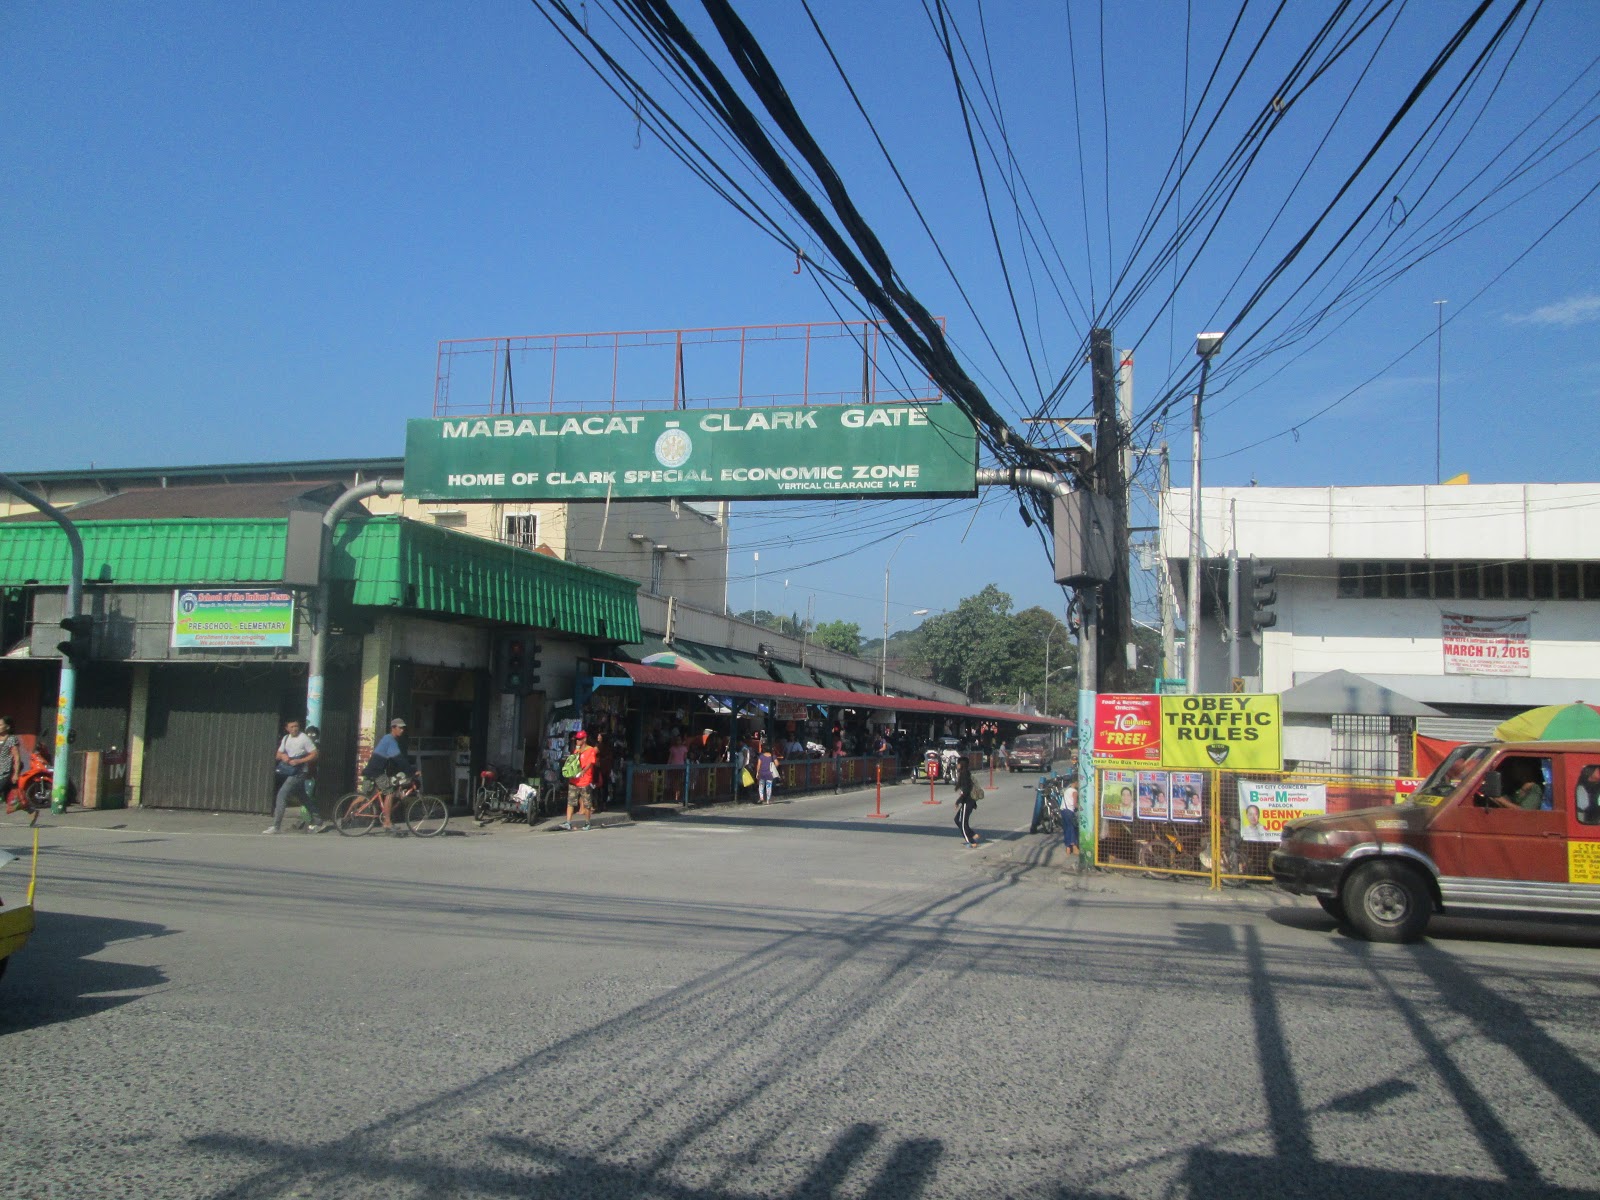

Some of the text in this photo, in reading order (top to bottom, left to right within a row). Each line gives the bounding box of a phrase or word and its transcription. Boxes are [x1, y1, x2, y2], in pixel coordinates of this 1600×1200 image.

[442, 416, 645, 438] MABALACAT
[699, 410, 818, 432] CLARK
[840, 407, 928, 428] GATE
[448, 464, 920, 487] HOME OF CLARK SPECIAL ECONOMIC ZONE
[777, 482, 822, 490] VERTICAL
[823, 481, 883, 490] CLEARANCE
[887, 480, 900, 488] 14
[197, 592, 289, 602] School of the Infant Jesus
[188, 622, 233, 630] PRE-SCHOOL
[239, 622, 286, 630] ELEMENTARY
[1443, 643, 1530, 658] MARCH 17, 2015
[1182, 697, 1252, 711] OBEY
[1114, 713, 1138, 731] 10
[1124, 718, 1152, 726] minutes
[1164, 712, 1272, 726] TRAFFIC
[1106, 731, 1147, 746] FREE!
[1177, 727, 1260, 741] RULES
[1249, 790, 1309, 803] Board Member
[1262, 809, 1302, 819] BENNY
